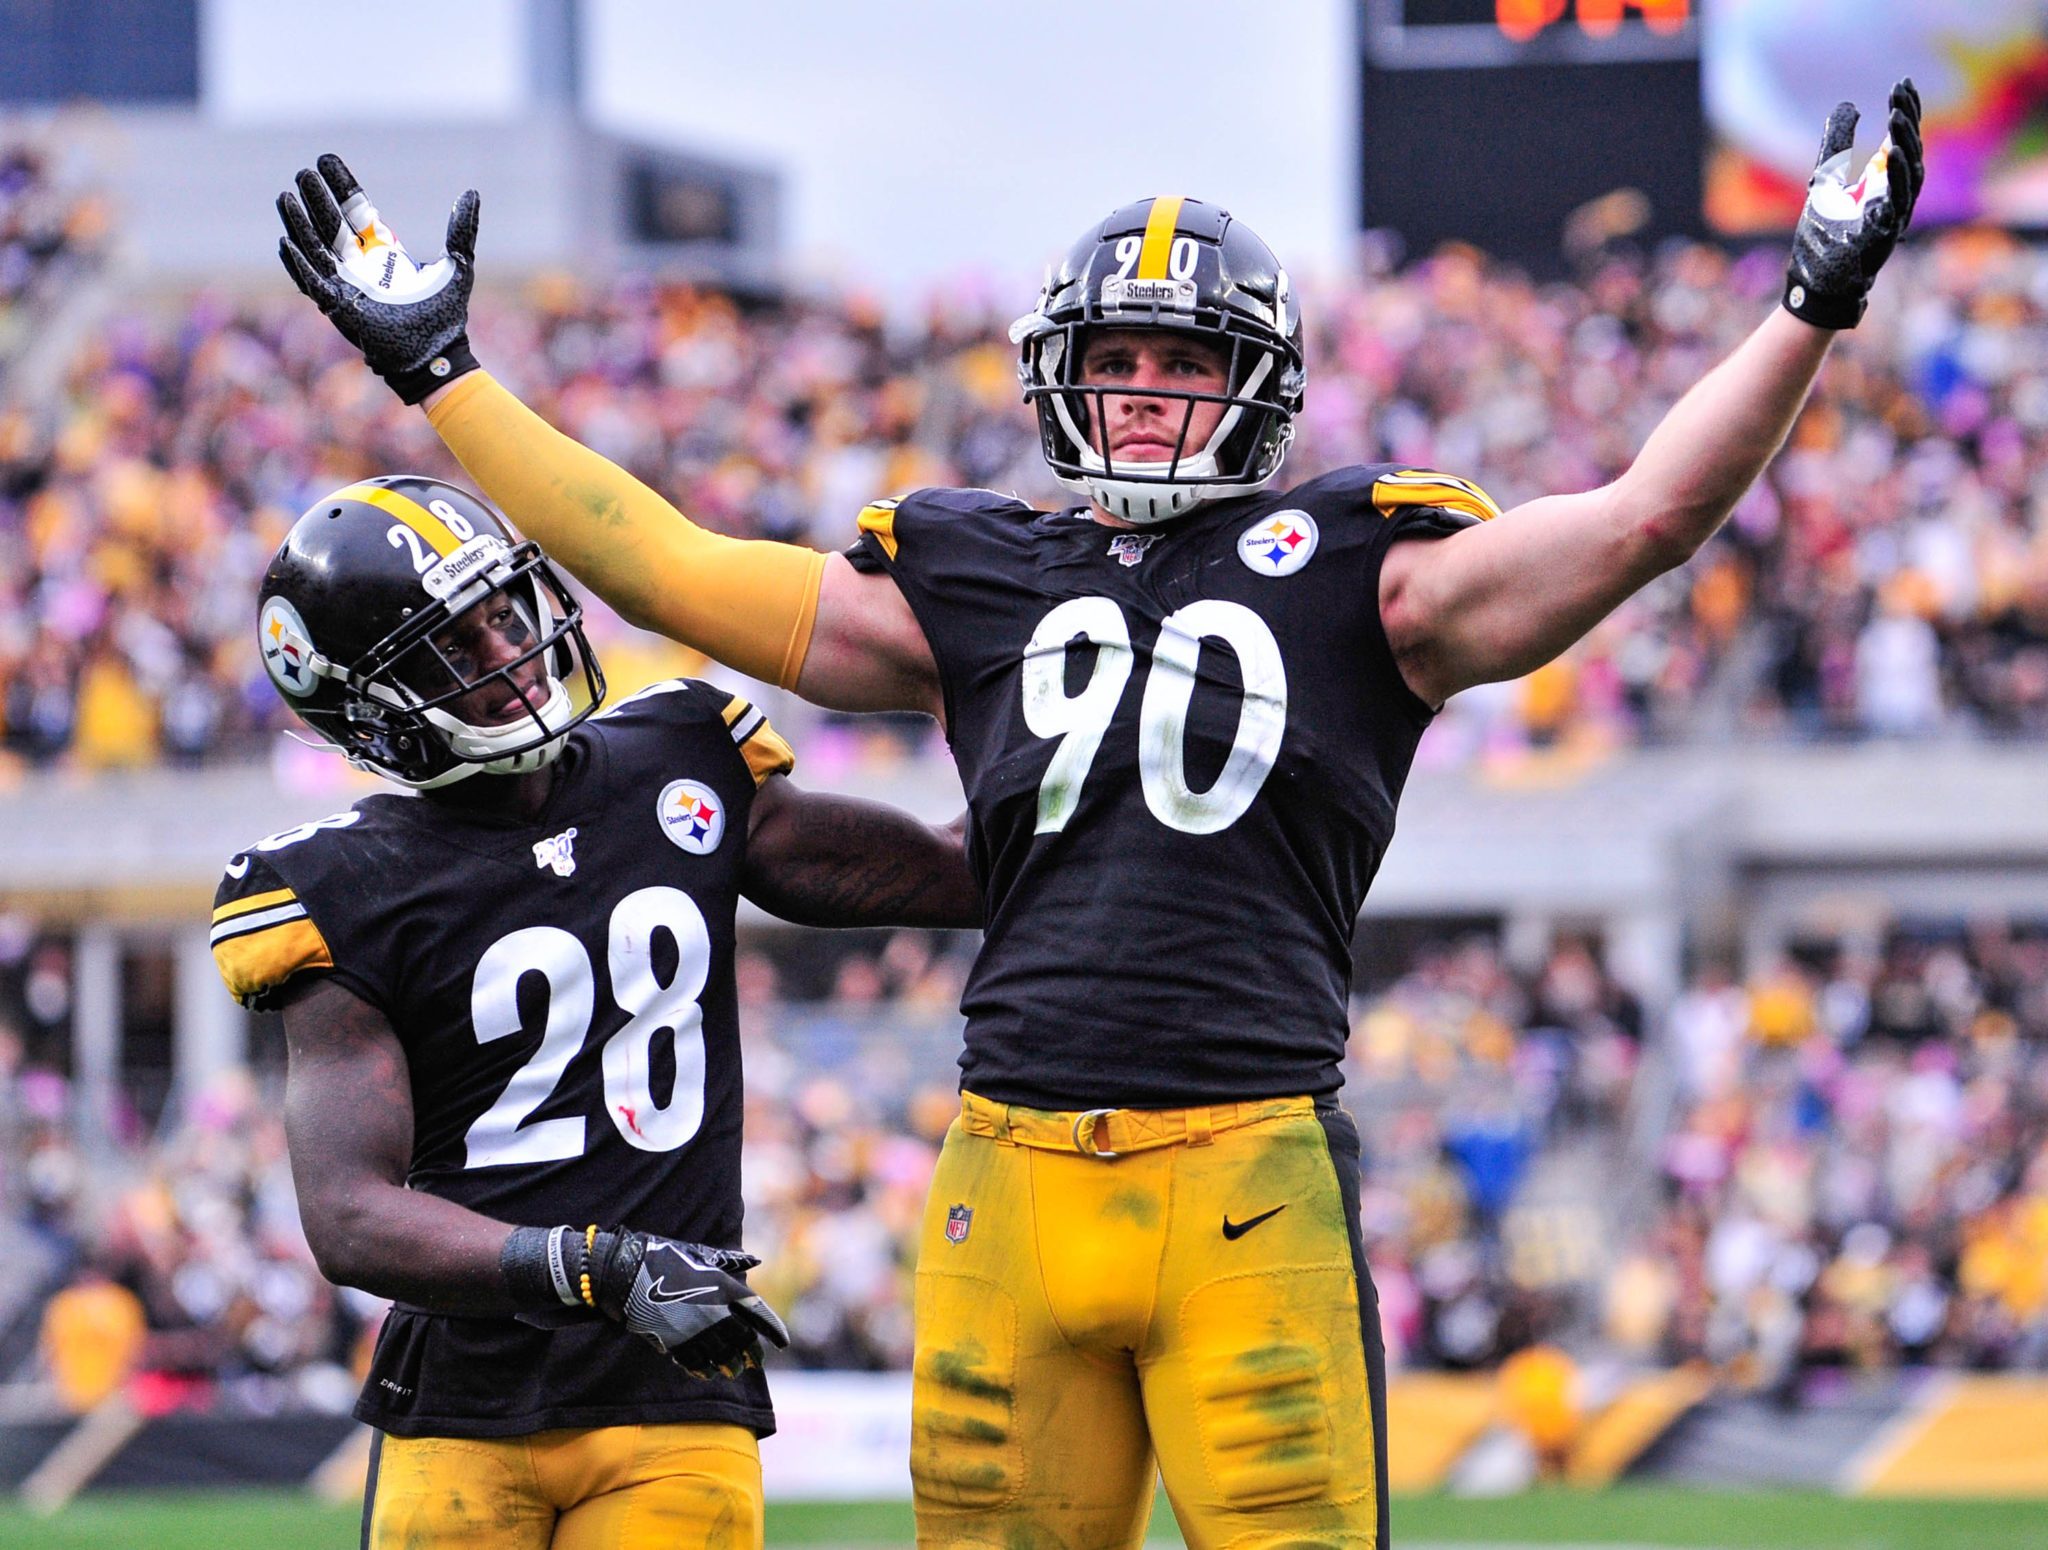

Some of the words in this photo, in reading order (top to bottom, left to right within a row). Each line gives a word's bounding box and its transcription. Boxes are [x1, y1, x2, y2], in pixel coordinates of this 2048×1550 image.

[378, 251, 398, 289] Steelers
[1114, 236, 1199, 280] 90
[1127, 282, 1174, 299] Steelers
[386, 499, 475, 574] 28
[1246, 537, 1275, 547] Steelers
[443, 547, 485, 578] Steelers
[1022, 596, 1287, 835] 90
[463, 885, 711, 1169] 28
